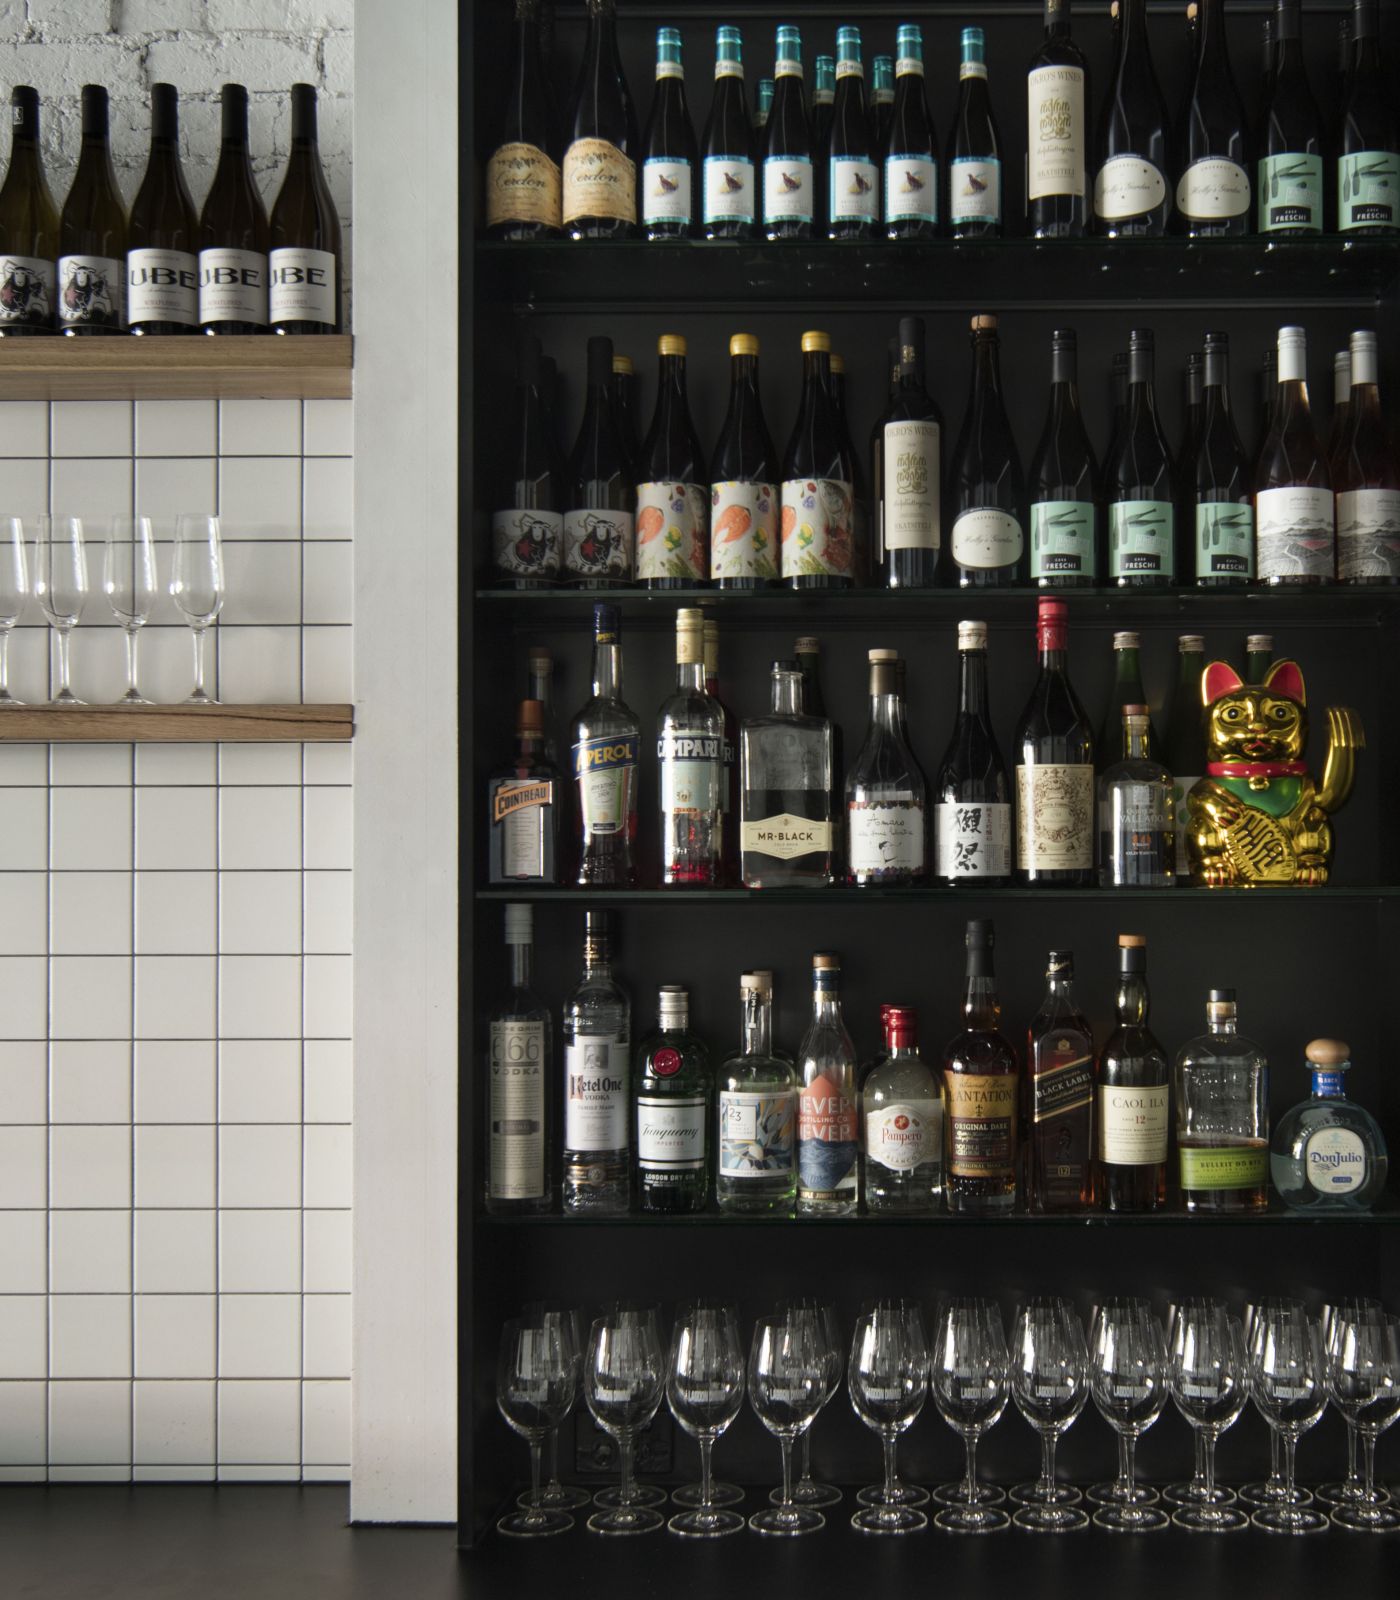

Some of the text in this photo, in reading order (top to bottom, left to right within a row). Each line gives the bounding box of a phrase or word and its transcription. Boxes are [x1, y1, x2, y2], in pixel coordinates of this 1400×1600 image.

[1275, 214, 1306, 222] FRESCHI
[1356, 213, 1388, 221] FRESCHI
[1046, 562, 1076, 570] FRESCHI
[1125, 562, 1156, 570] FRESCHI
[498, 787, 546, 815] COINTREAU
[492, 1035, 539, 1061] 666
[570, 1075, 601, 1097] Ketel
[1036, 1082, 1064, 1098] BLACK
[1065, 1072, 1092, 1088] LABEL
[1135, 1115, 1146, 1124] 12
[954, 1122, 989, 1131] ORIGINAL
[642, 1123, 699, 1140] Tanqueray
[882, 1128, 922, 1145] Pampero
[645, 1173, 669, 1181] LONDON
